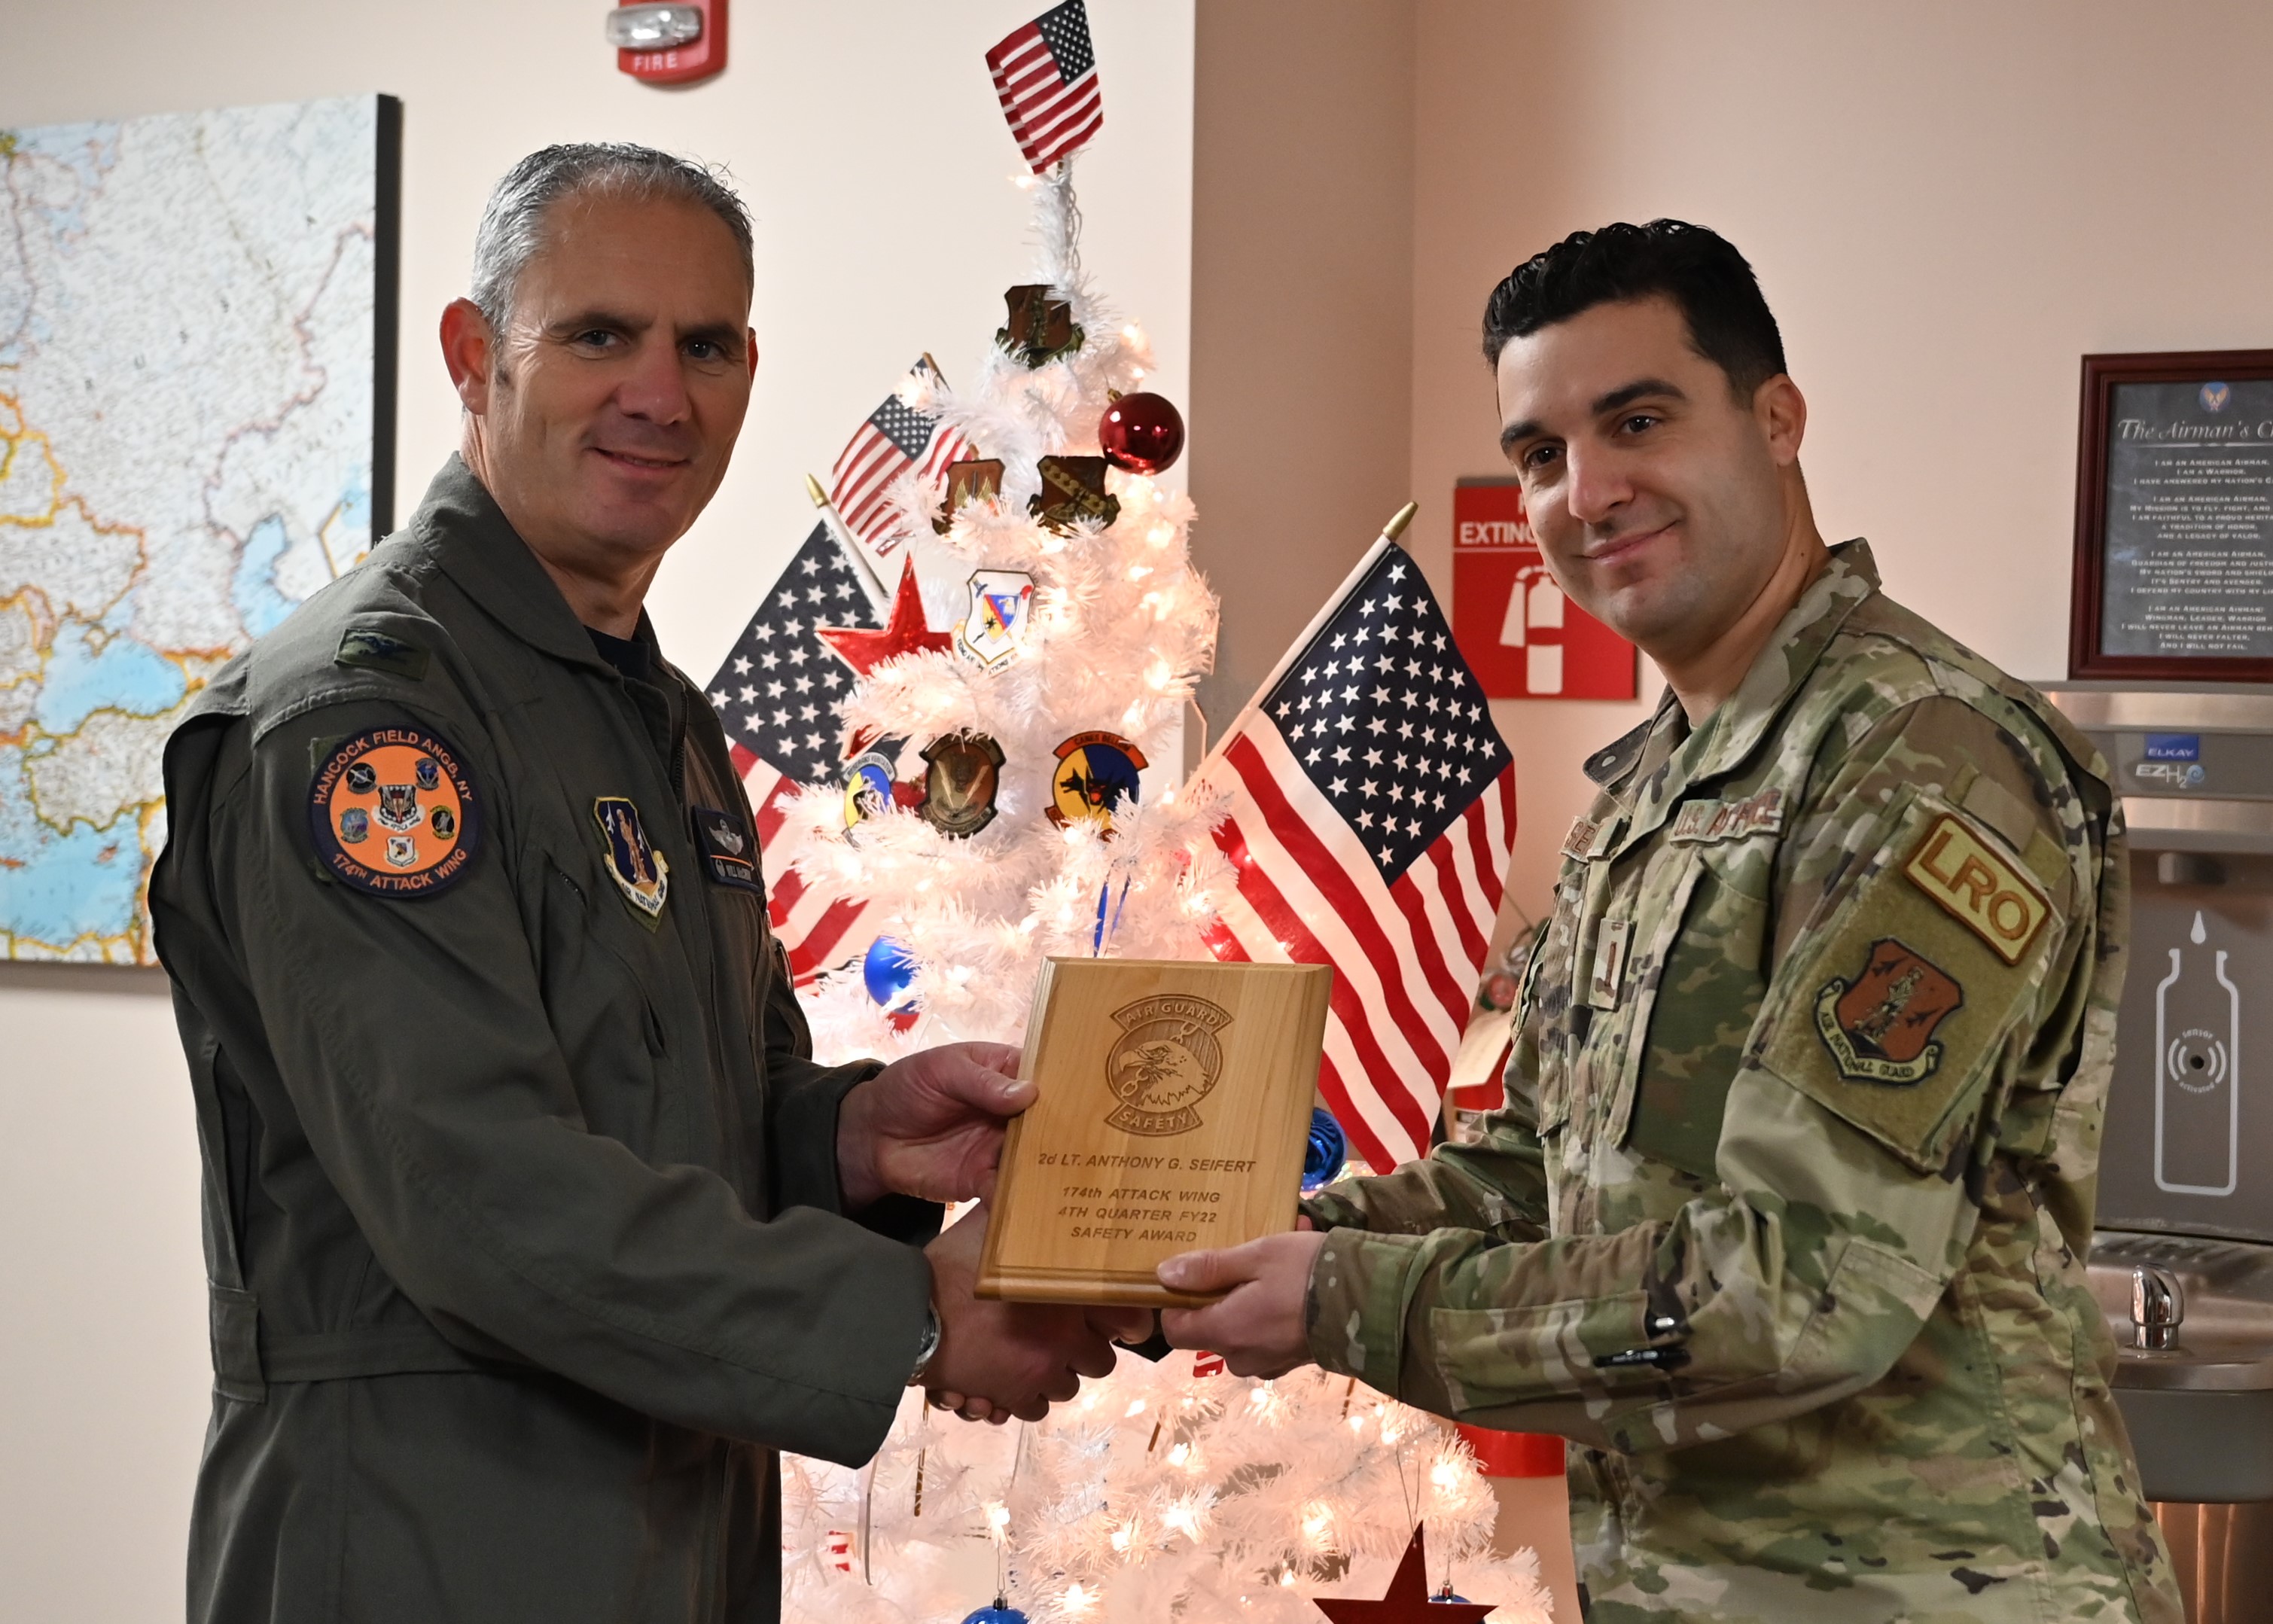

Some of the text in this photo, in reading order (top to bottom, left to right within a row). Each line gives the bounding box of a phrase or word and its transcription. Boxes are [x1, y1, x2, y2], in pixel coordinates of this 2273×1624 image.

[633, 53, 678, 72] FIRE
[2118, 419, 2154, 440] The
[2158, 419, 2250, 440] Airman's
[2148, 748, 2194, 757] ELKAY
[313, 730, 472, 804] HANCOCK FIELD ANGB, NY
[333, 848, 468, 890] 174TH ATTACK WING
[1918, 830, 2029, 940] LRO
[1126, 1002, 1218, 1025] AIR GUARD
[1119, 1111, 1188, 1129] SAFETY
[1038, 1153, 1257, 1173] 2d LT. ANTHONY G. SEIFERT
[1062, 1187, 1220, 1203] 174th ATTACK WING
[1058, 1206, 1217, 1223] 4TH QUARTER FY22
[1071, 1226, 1197, 1243] SAFETY AWARD
